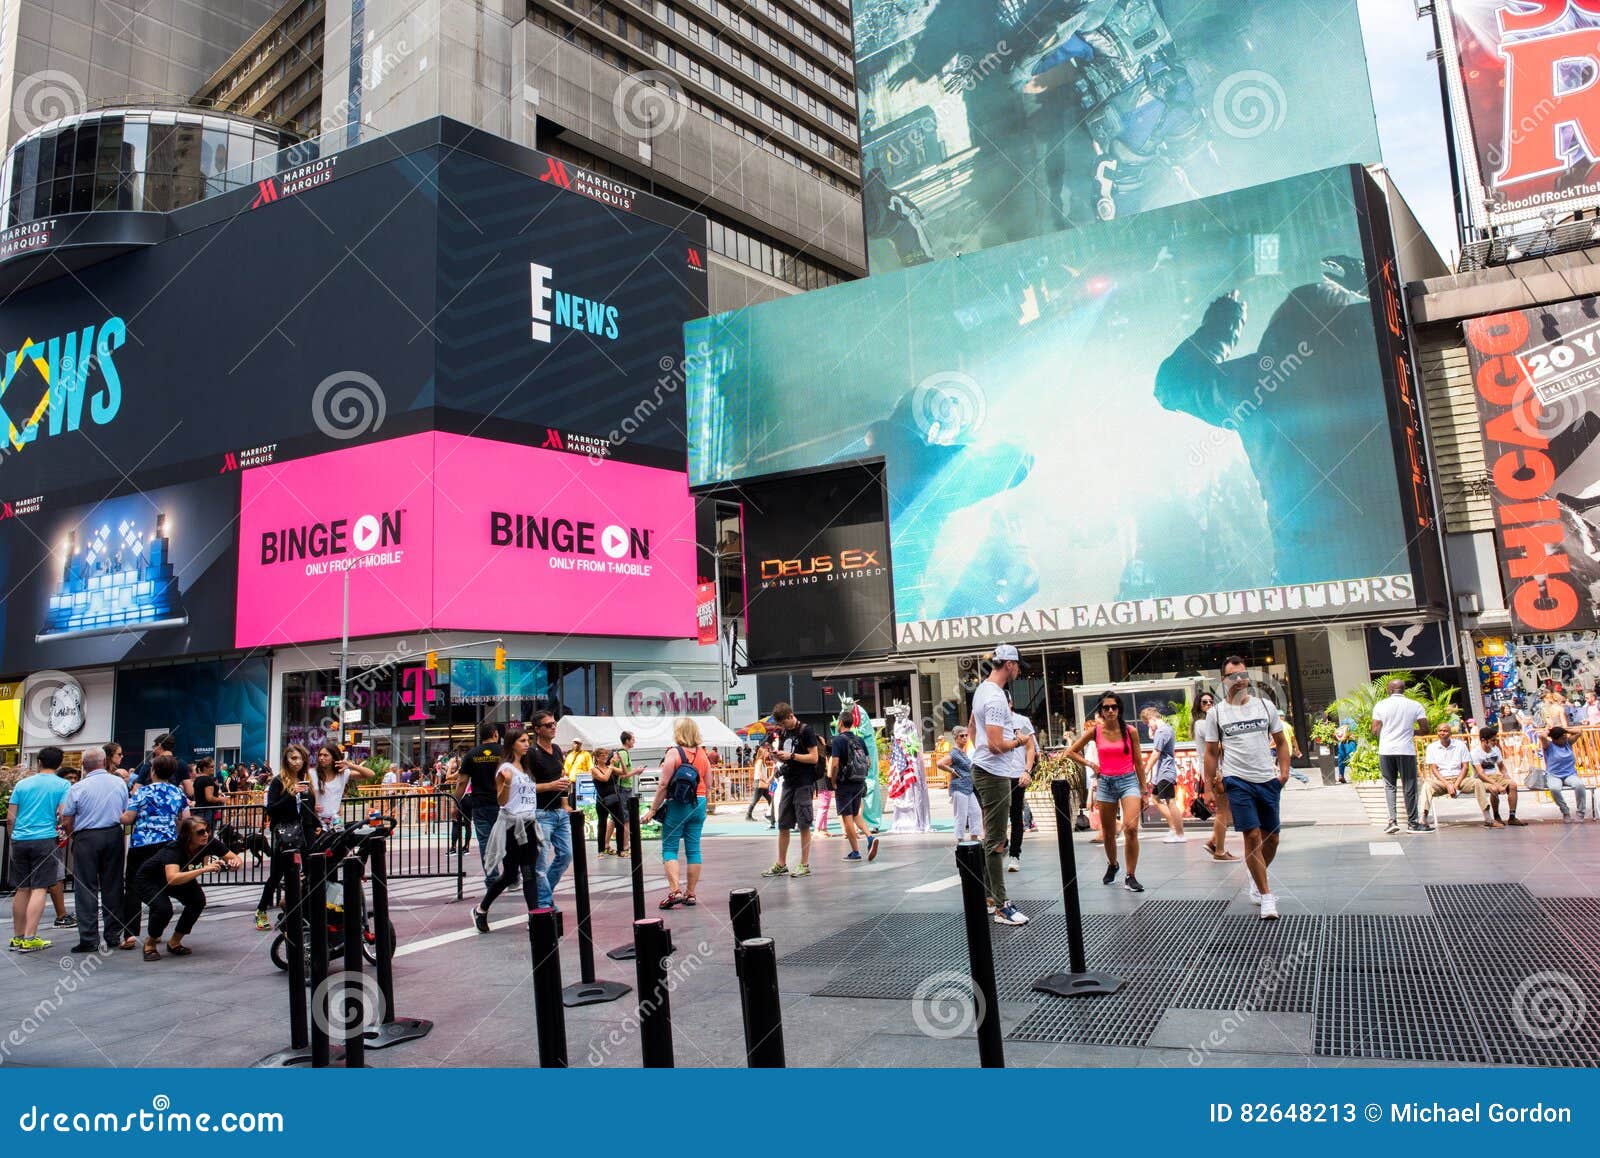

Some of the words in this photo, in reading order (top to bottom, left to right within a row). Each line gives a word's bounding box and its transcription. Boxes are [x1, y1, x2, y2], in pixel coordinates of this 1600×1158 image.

[282, 156, 338, 183] MARRIOTT
[282, 171, 331, 195] MARQUIS
[577, 169, 637, 200] MARRIOTT
[577, 182, 631, 209] MARQUIS
[1, 220, 57, 243] MARRIOTT
[0, 234, 48, 256] MARQUIS
[555, 290, 619, 340] NEWS
[1528, 345, 1575, 379] 20
[1571, 329, 1600, 357] Y
[1548, 370, 1594, 394] KILLING
[241, 444, 277, 459] MARRIOTT
[567, 433, 610, 448] MARRIOTT
[567, 443, 606, 456] MARQUIS
[240, 454, 272, 467] MARQUIS
[1467, 309, 1579, 630] CHICAGO
[15, 496, 44, 507] MARRIOTT
[260, 519, 348, 566] BINGE
[491, 511, 596, 555] BINGE
[305, 561, 329, 576] ONLY
[329, 557, 358, 573] FROM
[549, 557, 575, 570] ONLY
[576, 559, 606, 573] FROM
[901, 607, 1061, 644] AMERICAN
[1071, 597, 1174, 627] EAGLE
[1184, 575, 1413, 618] OUTFITTERS
[1224, 721, 1257, 733] adidas
